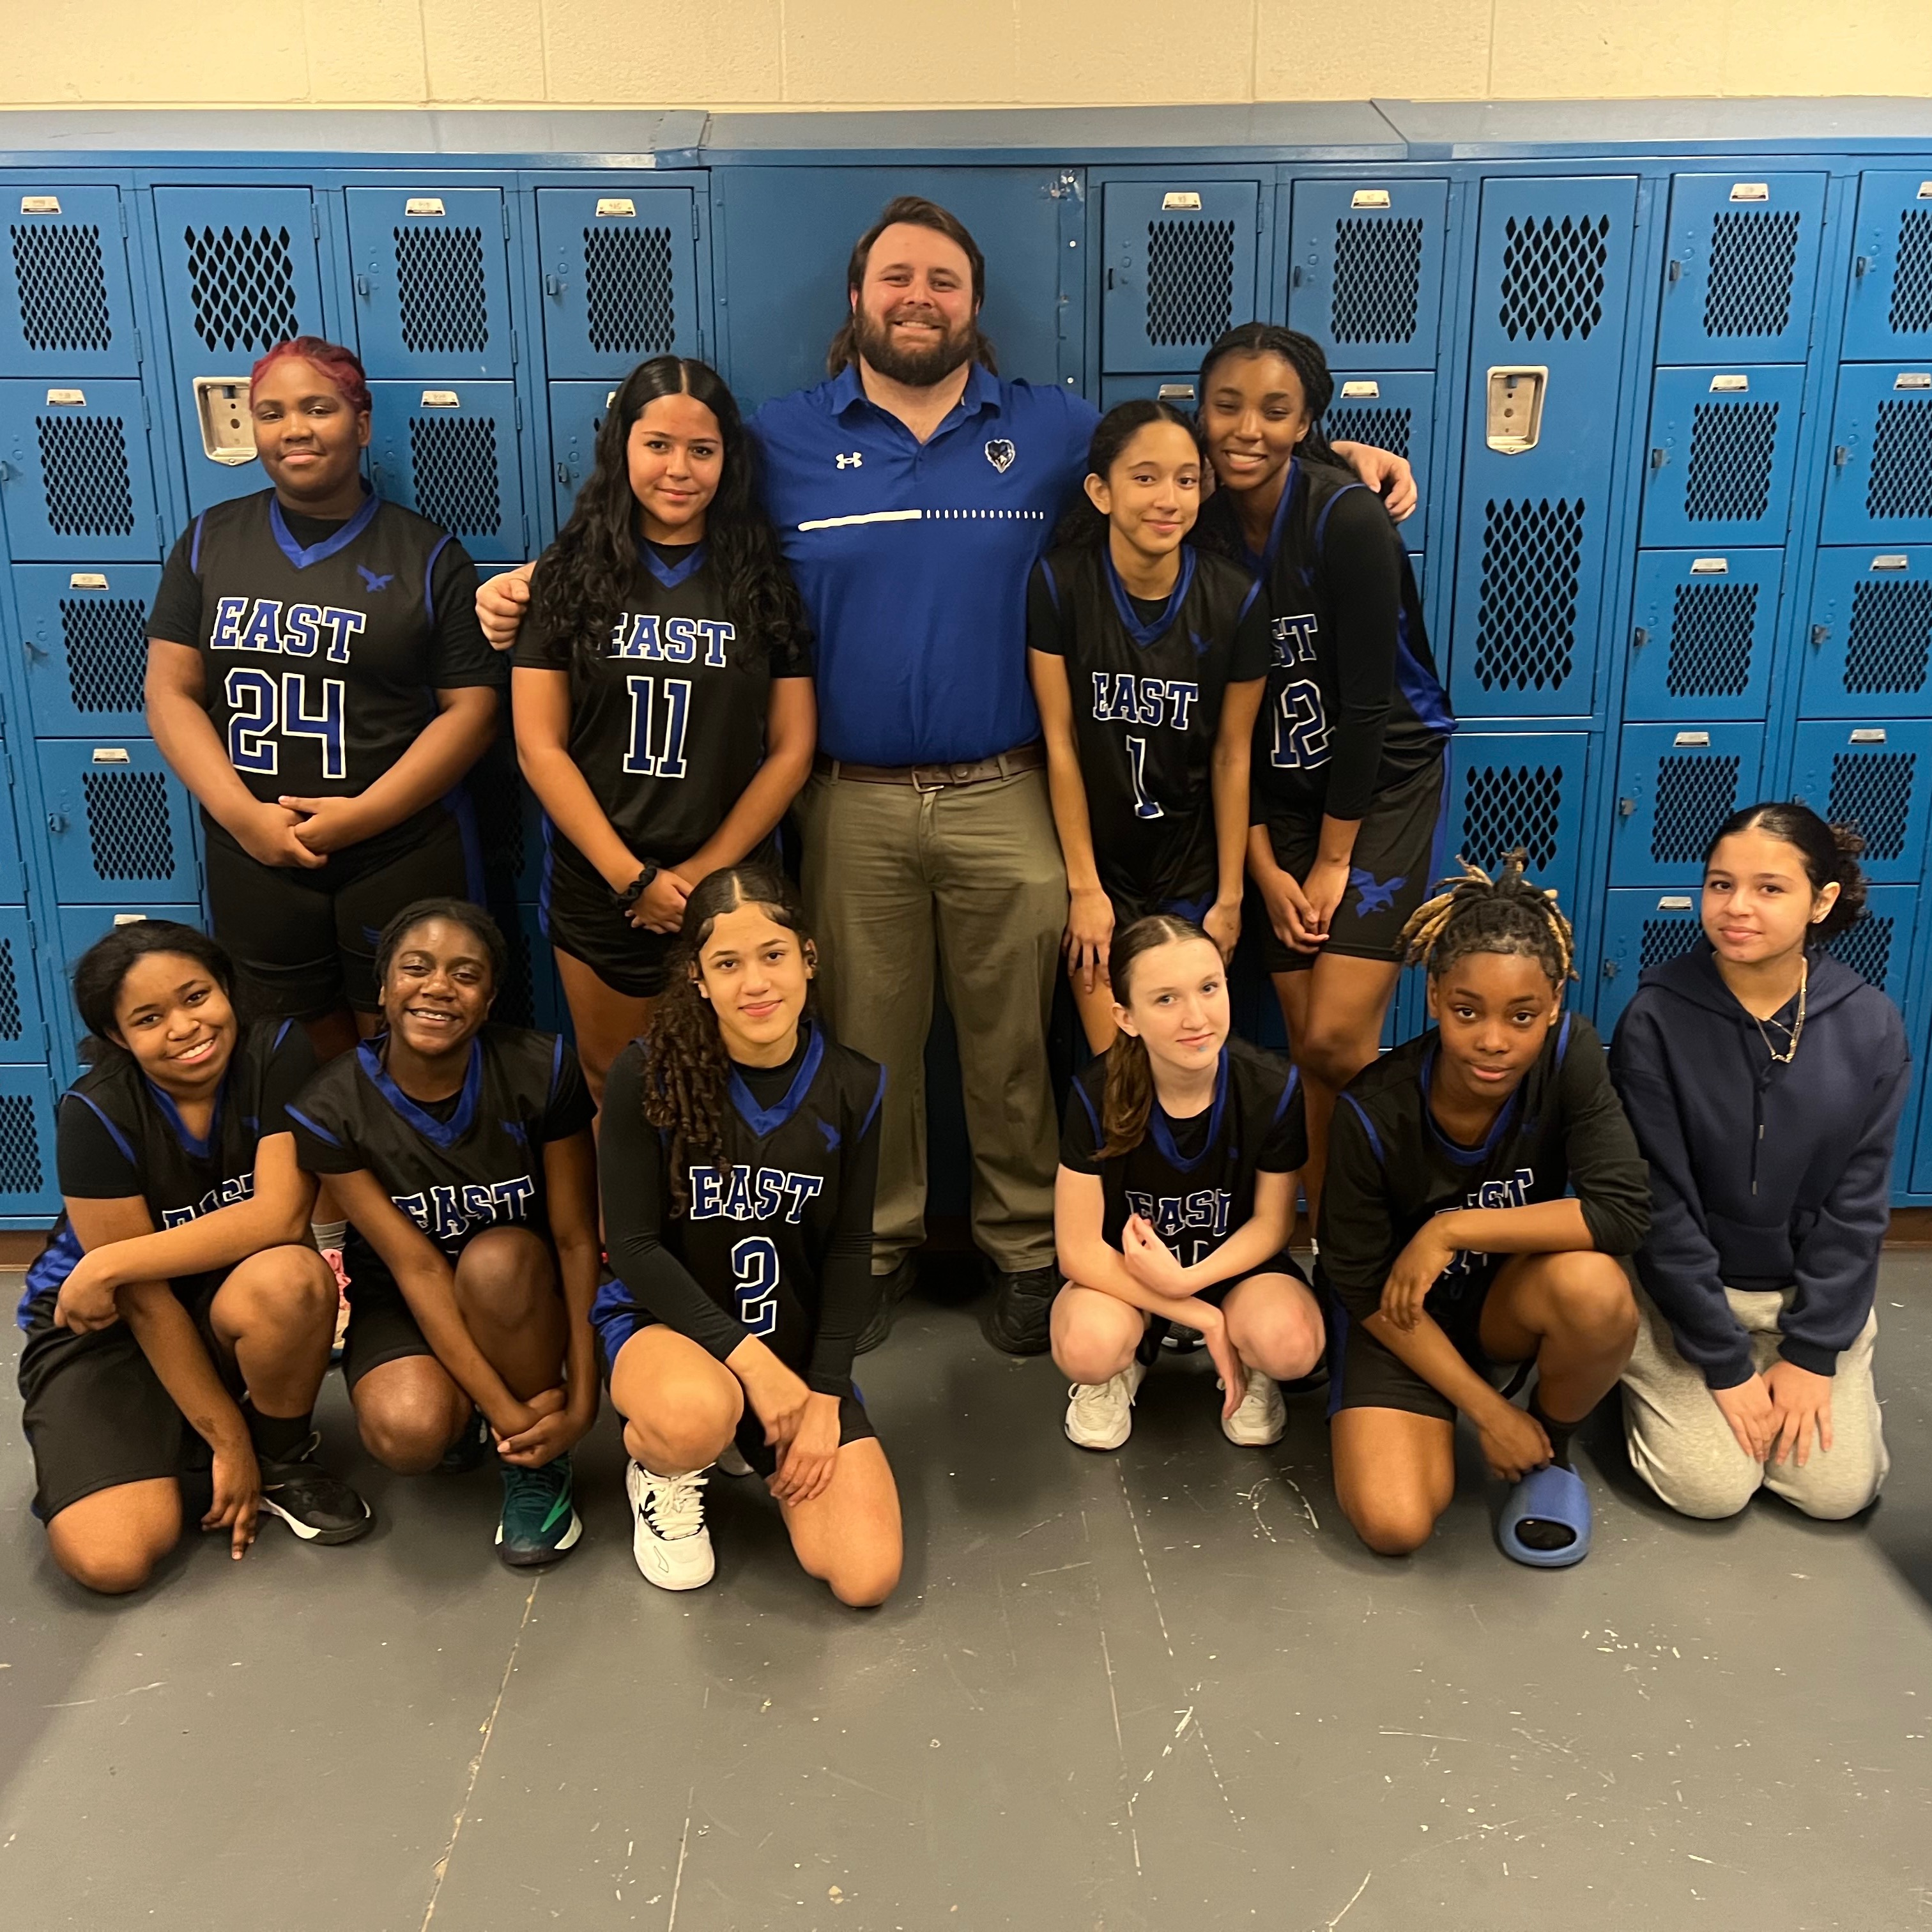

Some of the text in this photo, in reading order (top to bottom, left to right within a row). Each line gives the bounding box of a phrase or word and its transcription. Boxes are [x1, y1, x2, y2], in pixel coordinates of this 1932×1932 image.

[210, 597, 367, 664] EAST
[224, 668, 346, 778] 24
[623, 675, 692, 778] 11
[1092, 672, 1199, 730] EAST
[1270, 678, 1337, 770] 12
[1126, 735, 1165, 819] 1
[391, 1175, 535, 1239] EAST
[689, 1165, 824, 1224] EAST
[731, 1236, 779, 1337] 2
